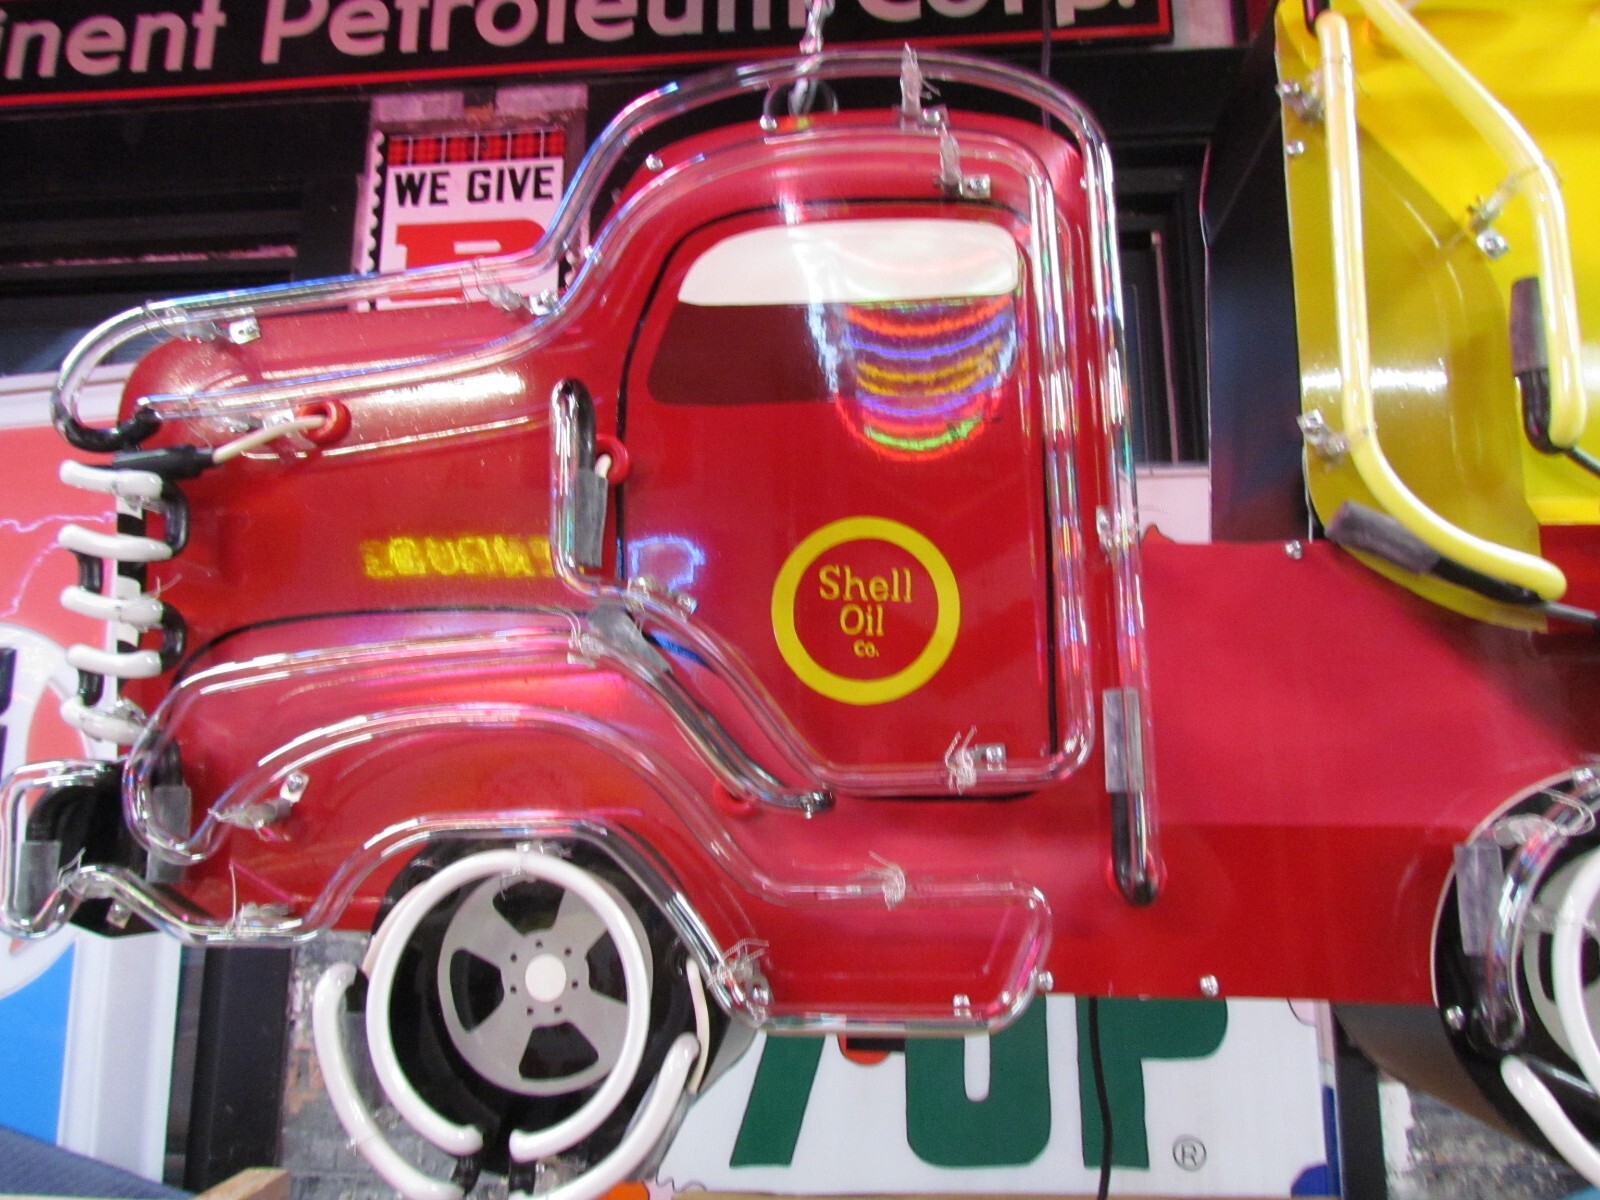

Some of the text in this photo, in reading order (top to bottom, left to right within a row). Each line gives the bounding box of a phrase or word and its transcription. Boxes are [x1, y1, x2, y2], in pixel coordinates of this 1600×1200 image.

[394, 166, 554, 208] WE GIVE
[818, 565, 912, 603] Shell
[839, 604, 884, 636] Oil
